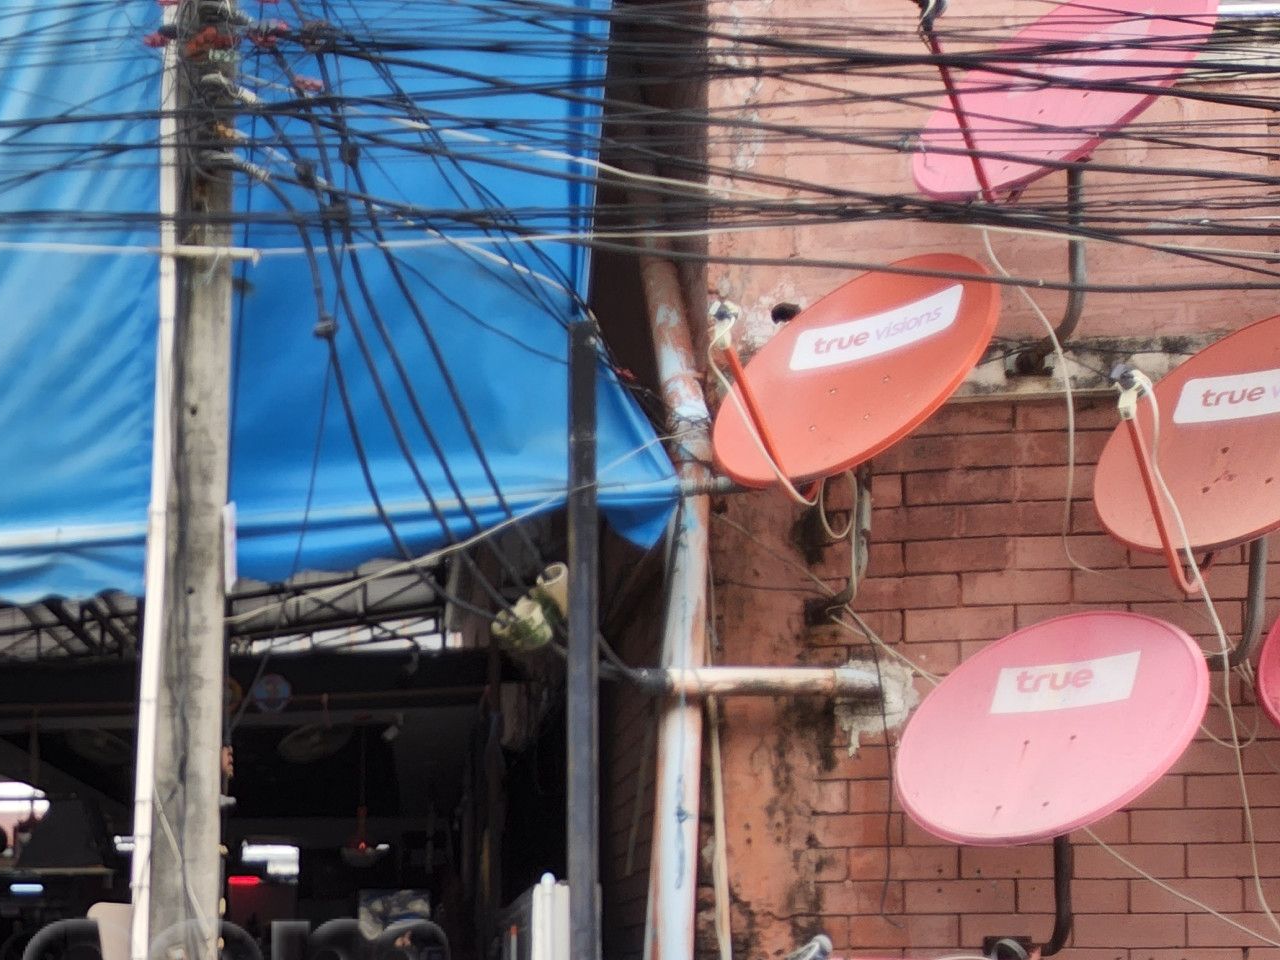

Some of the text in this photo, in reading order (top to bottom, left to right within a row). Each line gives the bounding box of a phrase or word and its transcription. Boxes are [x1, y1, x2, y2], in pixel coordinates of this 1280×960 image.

[814, 306, 943, 355] true visions
[1201, 385, 1266, 407] true
[1016, 668, 1094, 694] true
